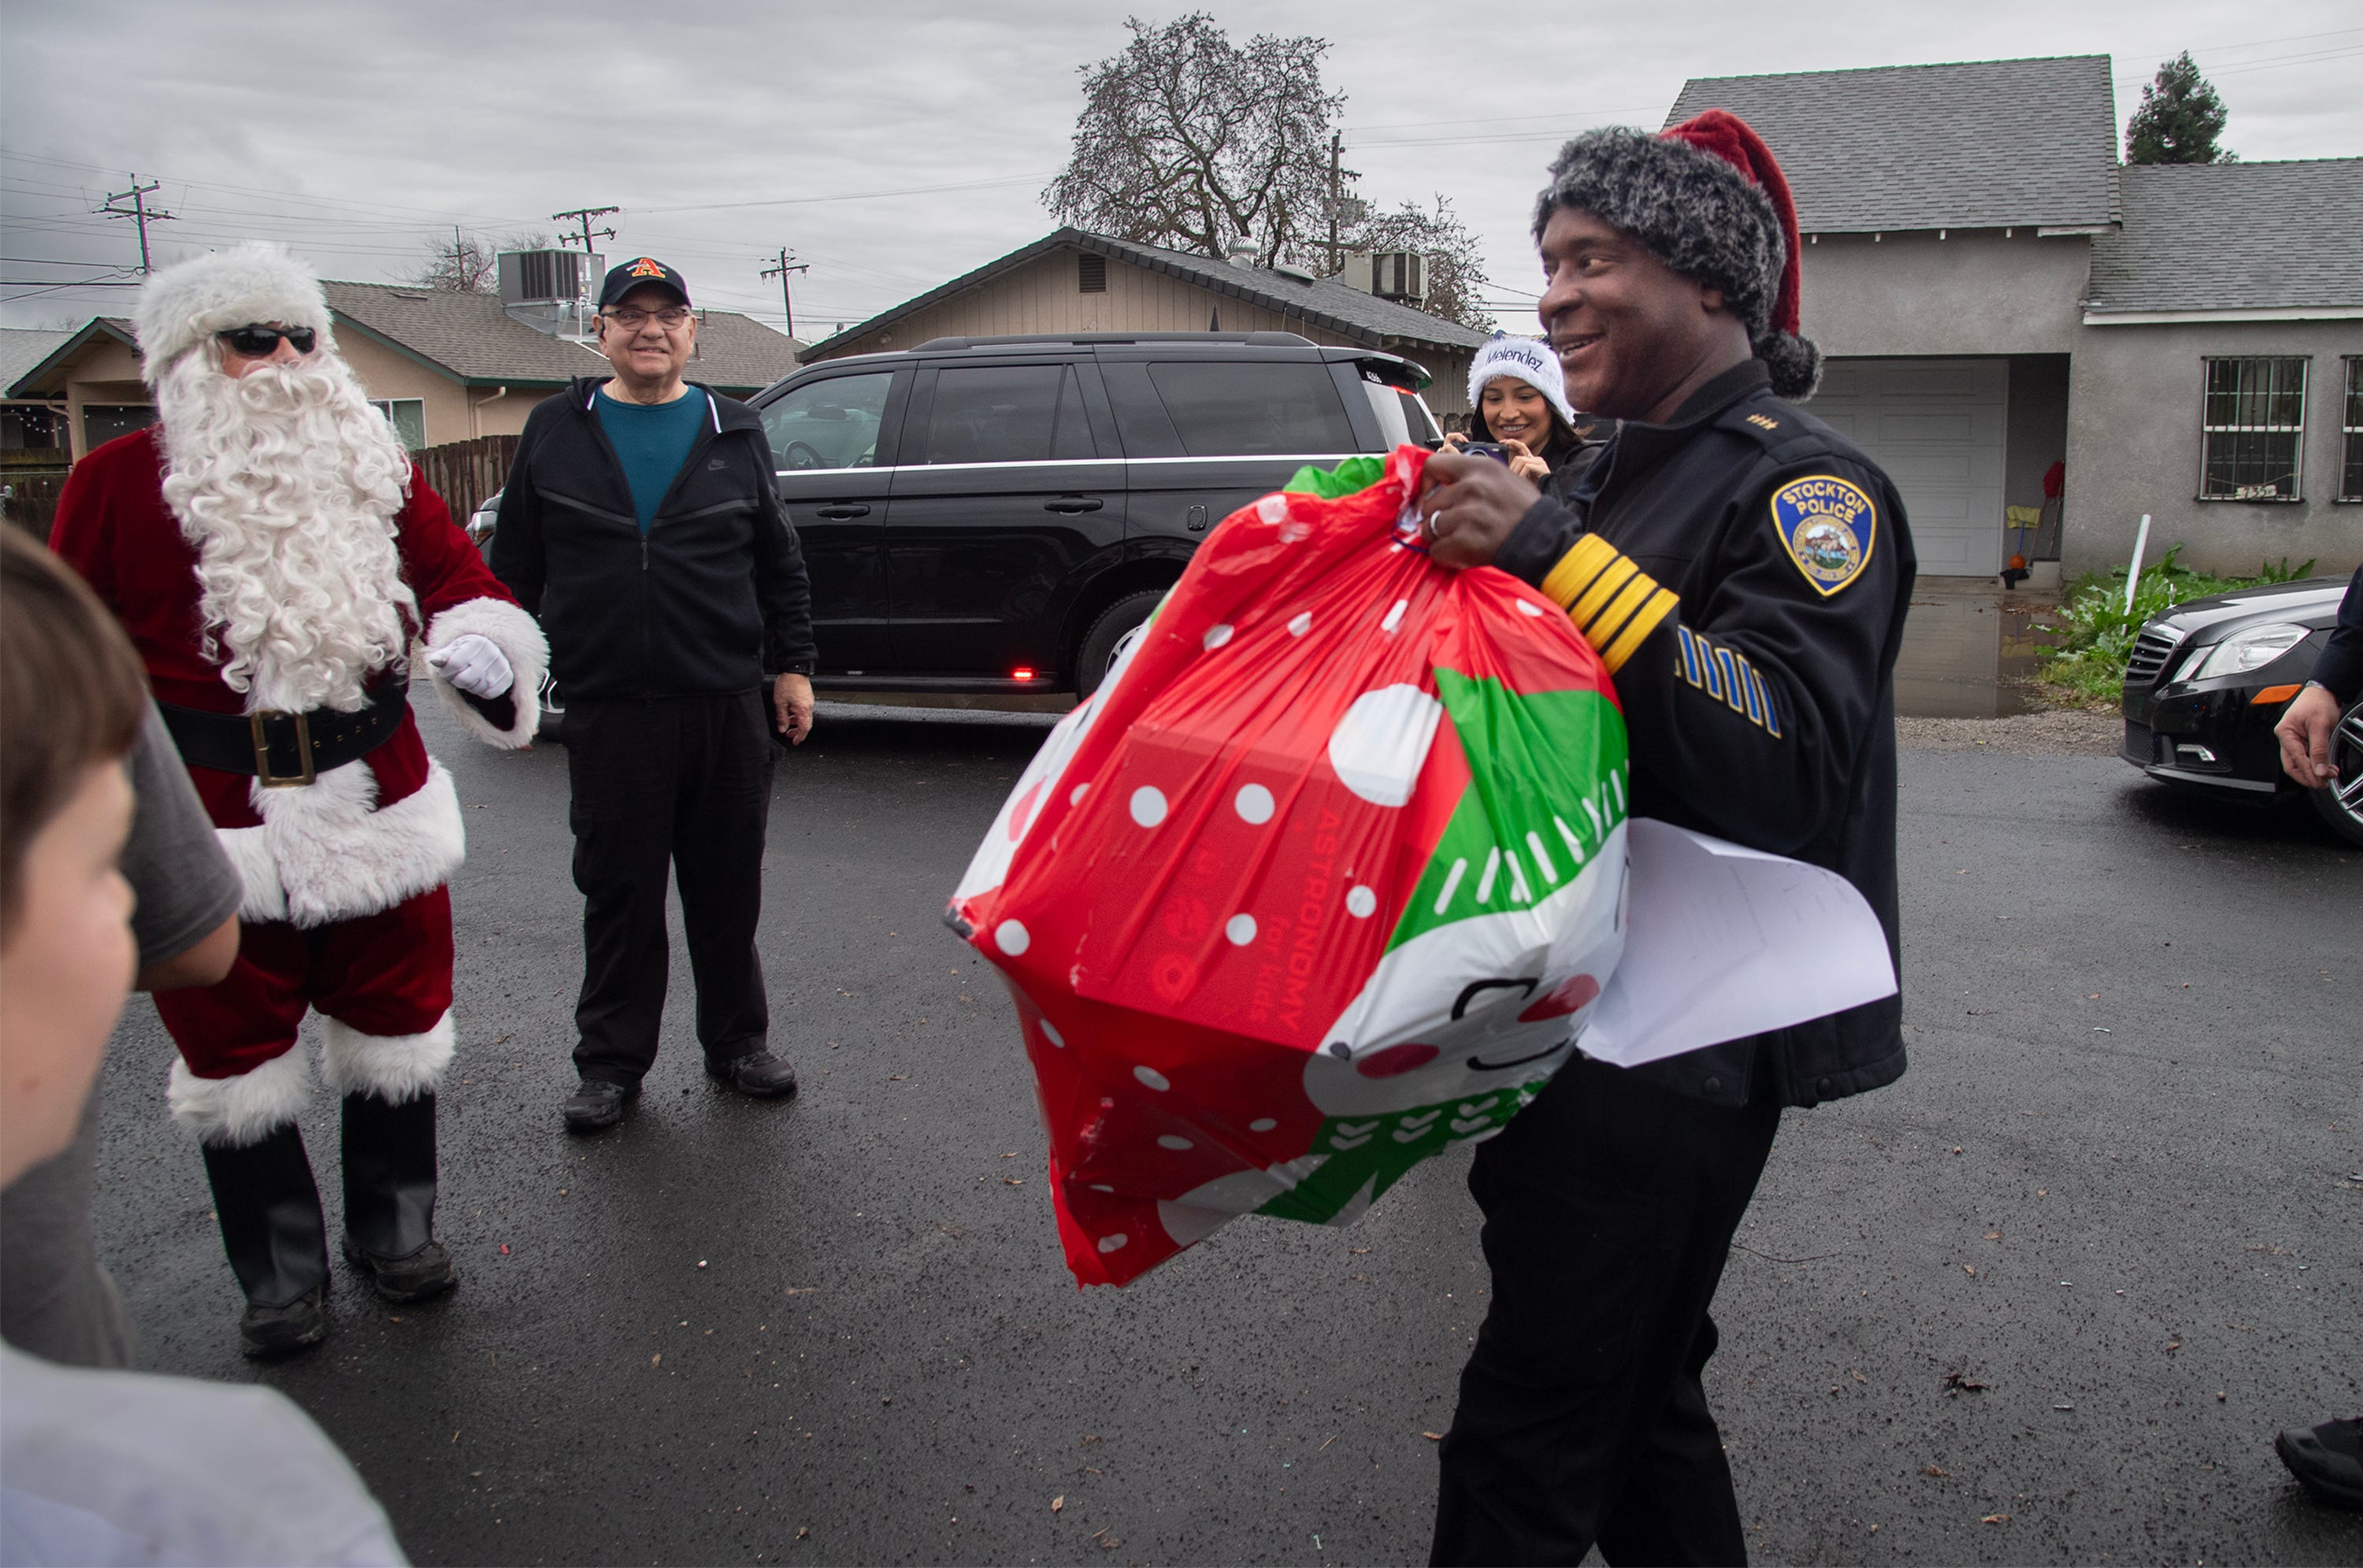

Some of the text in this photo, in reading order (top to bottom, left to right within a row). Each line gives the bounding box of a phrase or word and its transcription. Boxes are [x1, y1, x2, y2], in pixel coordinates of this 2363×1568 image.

[632, 258, 666, 278] A
[1486, 347, 1543, 373] Melendez
[1782, 481, 1867, 514] STOCKTON
[1796, 499, 1857, 524] POLICE
[1278, 807, 1341, 1032] ASTRONOMY
